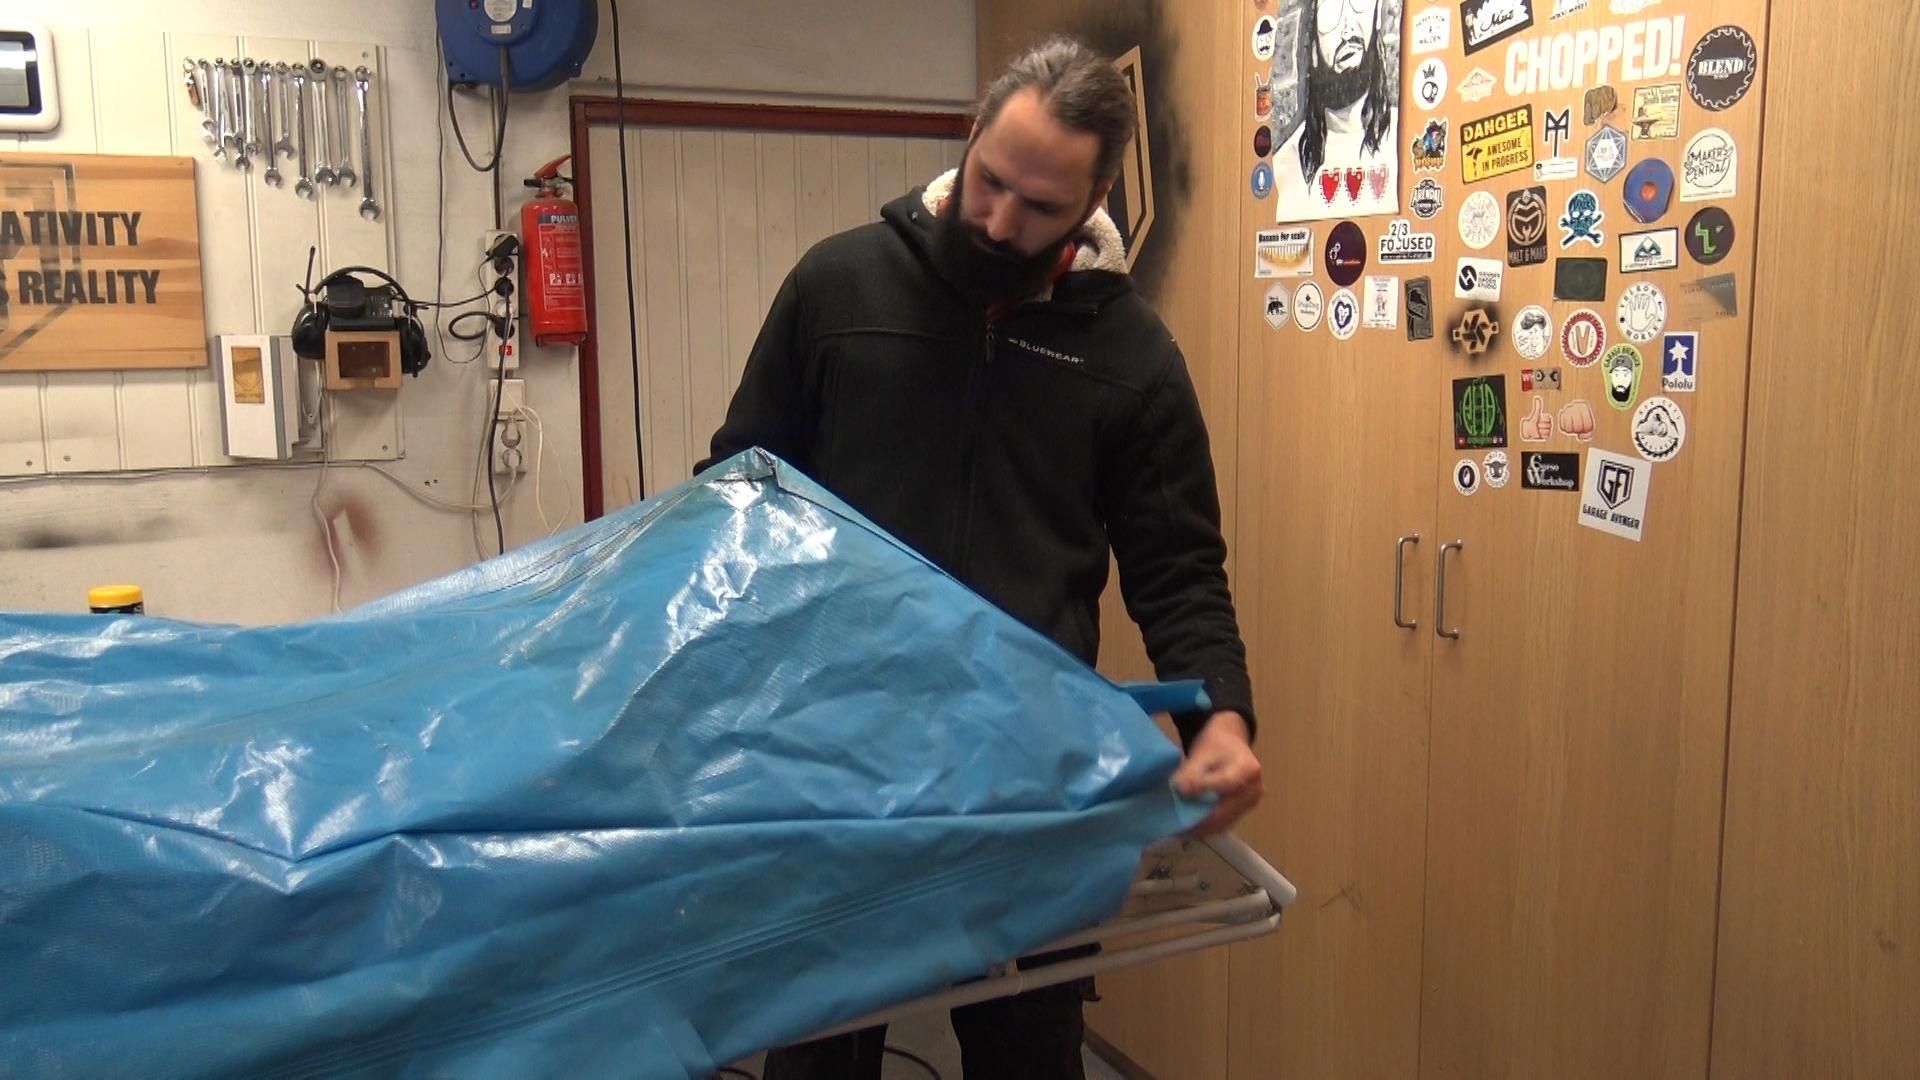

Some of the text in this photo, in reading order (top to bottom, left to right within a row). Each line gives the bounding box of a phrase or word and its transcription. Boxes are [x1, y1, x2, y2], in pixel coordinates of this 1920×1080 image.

[1504, 15, 1686, 97] CHOPPED!
[1697, 57, 1744, 76] BLEND
[1463, 109, 1529, 142] DANGER
[1487, 137, 1522, 156] AWESOME
[1482, 160, 1490, 172] IN
[1491, 149, 1529, 170] PROGRESS
[1390, 222, 1408, 236] 2/3
[1380, 237, 1433, 252] FOCUSED
[18, 269, 160, 304] REALITY
[1662, 377, 1693, 390] Pololu
[1527, 469, 1575, 490] Workshop
[1582, 504, 1640, 530] GARAGE AVENGER
